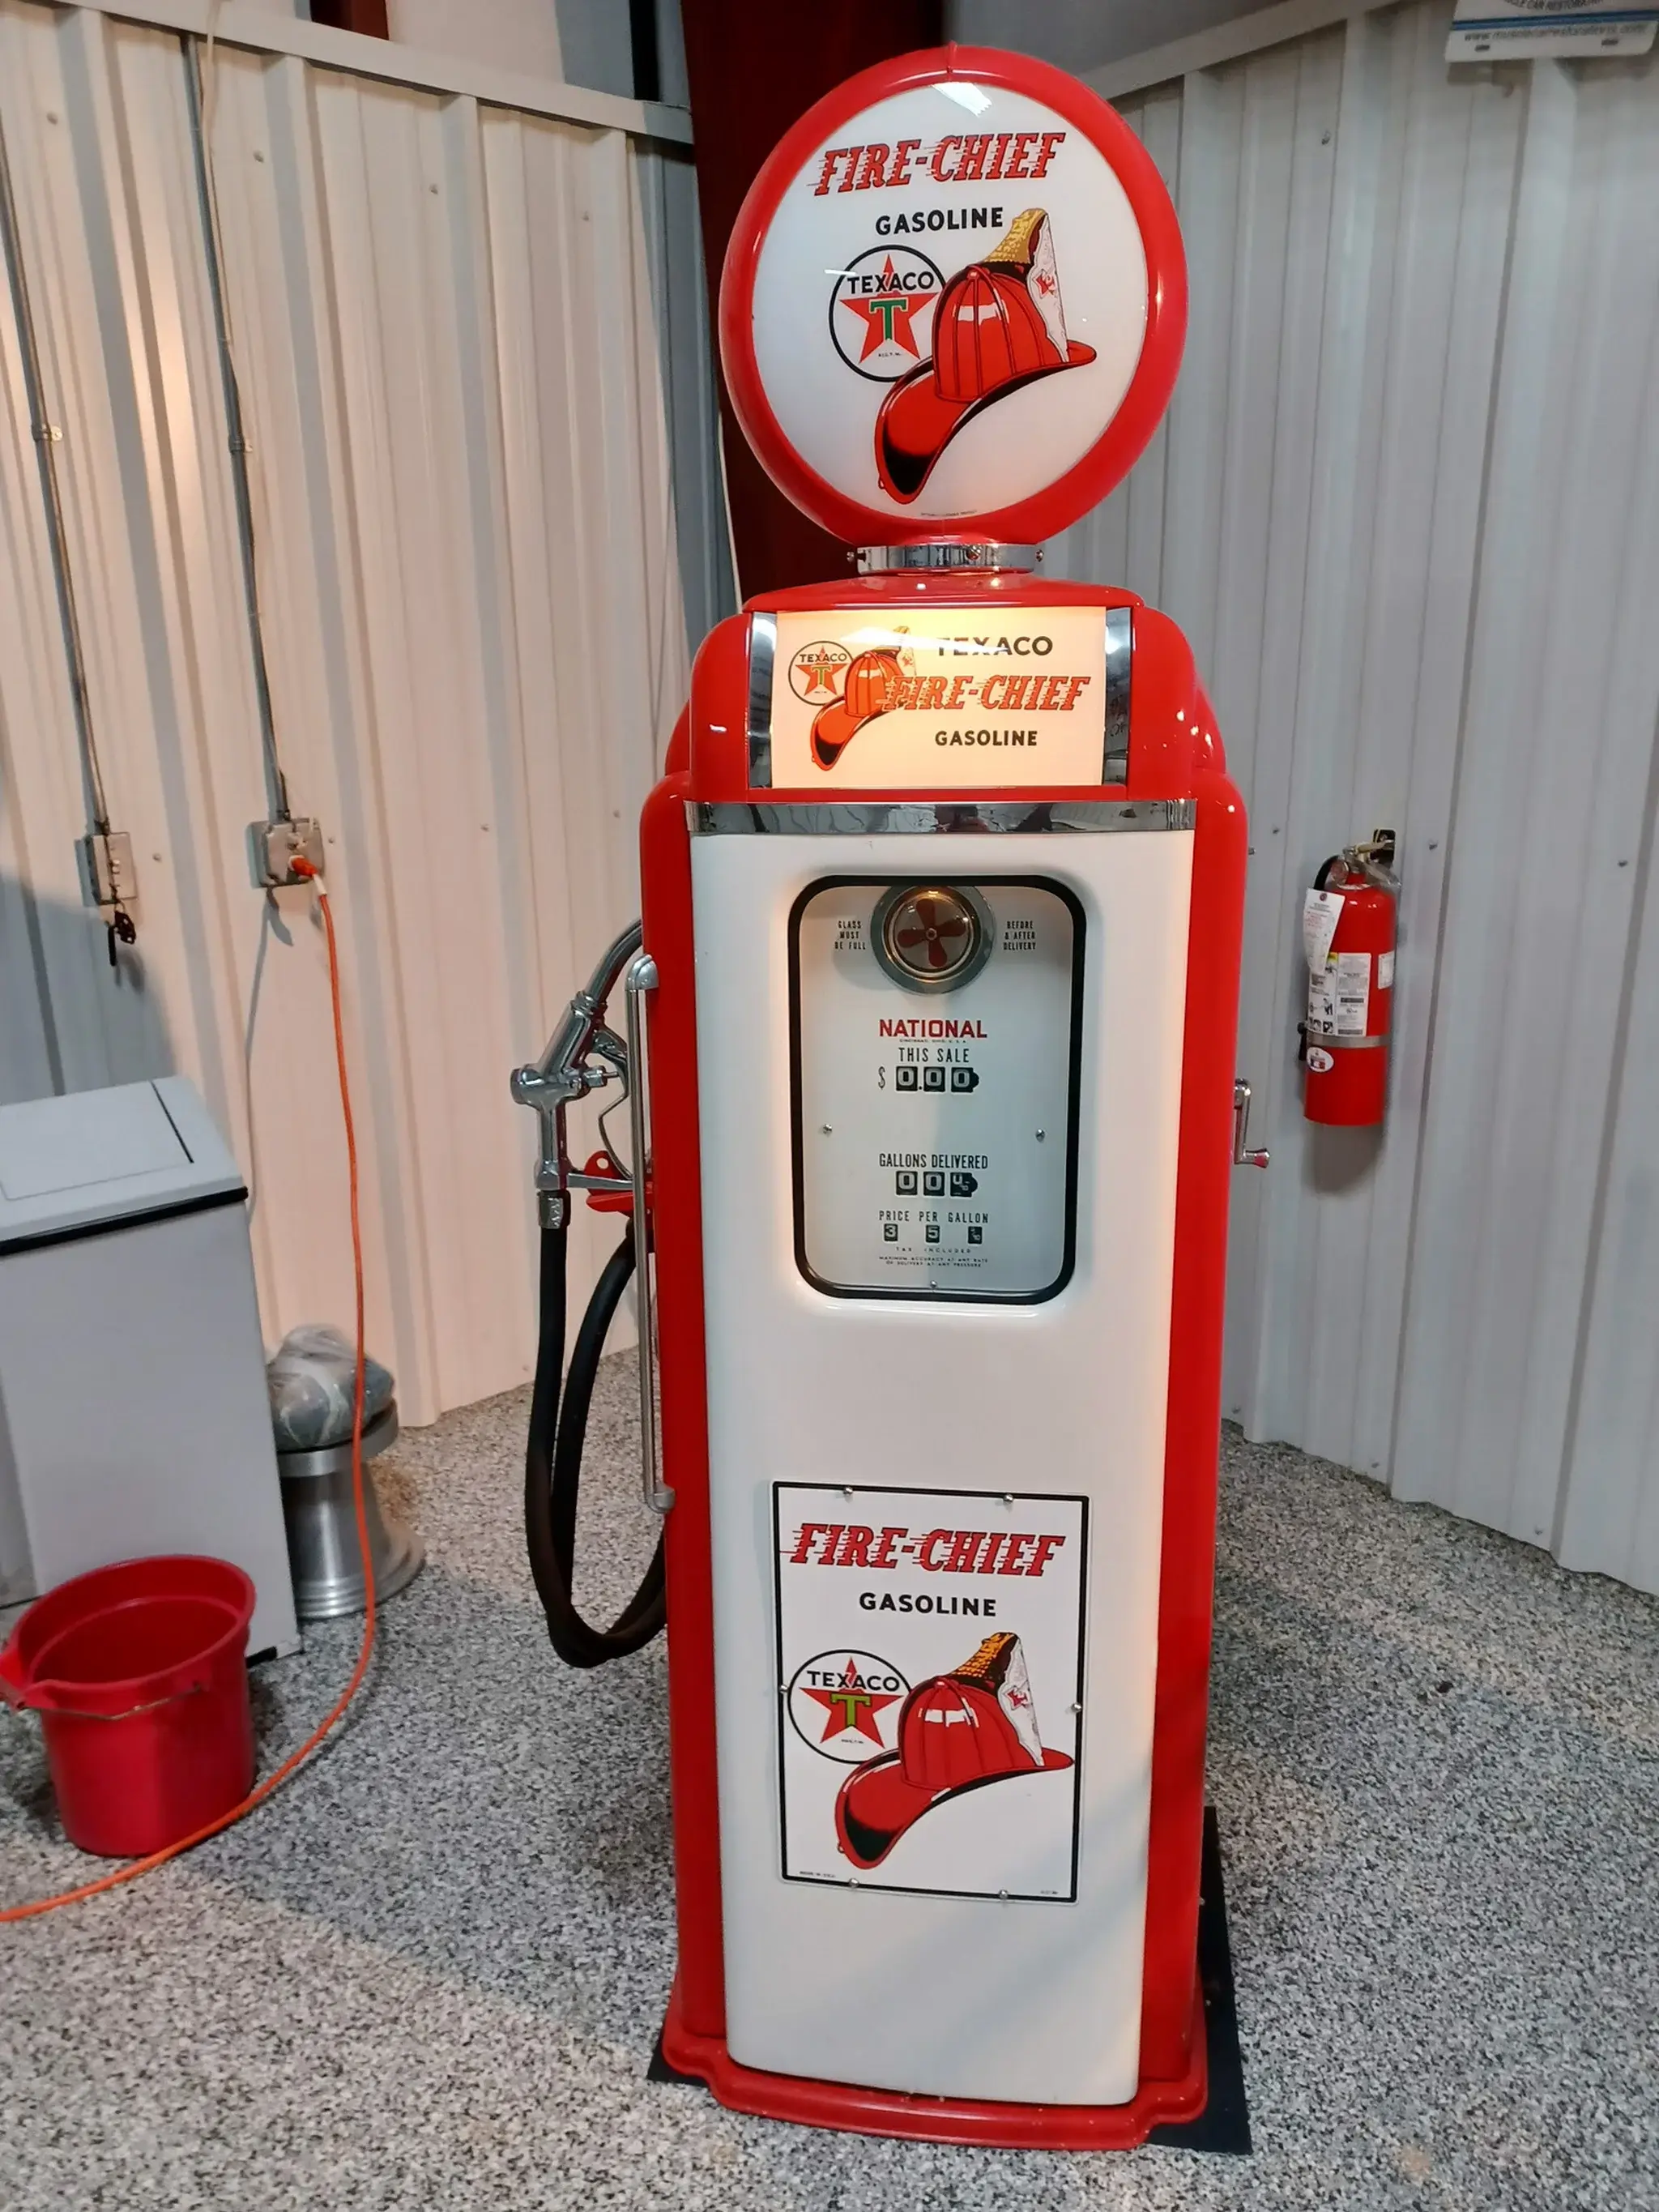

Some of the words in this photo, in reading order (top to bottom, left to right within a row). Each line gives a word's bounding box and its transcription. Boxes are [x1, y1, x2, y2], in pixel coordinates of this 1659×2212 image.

[810, 132, 1066, 196] FIRE-CHIEF
[875, 207, 1004, 236] GASOLINE
[847, 271, 935, 295] TEXACO
[868, 298, 907, 341] T
[799, 651, 847, 664] TEXACO
[811, 665, 834, 685] T
[881, 674, 1091, 711] FIRE-CHIEF
[934, 729, 1038, 747] GASOLINE
[838, 920, 861, 929] GLASS
[1007, 920, 1033, 929] BEFORE
[839, 931, 859, 939] MUST
[1013, 931, 1035, 940] AFTER
[834, 941, 843, 950] BE
[849, 941, 866, 950] FULL
[1003, 942, 1036, 950] DELIVERY
[879, 1018, 988, 1038] NATIONAL
[898, 1047, 929, 1062] THIS
[936, 1048, 970, 1063] SALE
[879, 1153, 928, 1168] GALLONS
[931, 1154, 989, 1169] DELIVERED
[879, 1210, 910, 1222] PRICE
[919, 1211, 939, 1222] PER
[948, 1212, 989, 1223] GALLON
[788, 1522, 1066, 1577] FIRE-CHIEF
[859, 1591, 997, 1617] GASOLINE
[806, 1670, 900, 1693] TEXACO
[830, 1693, 872, 1728] T
